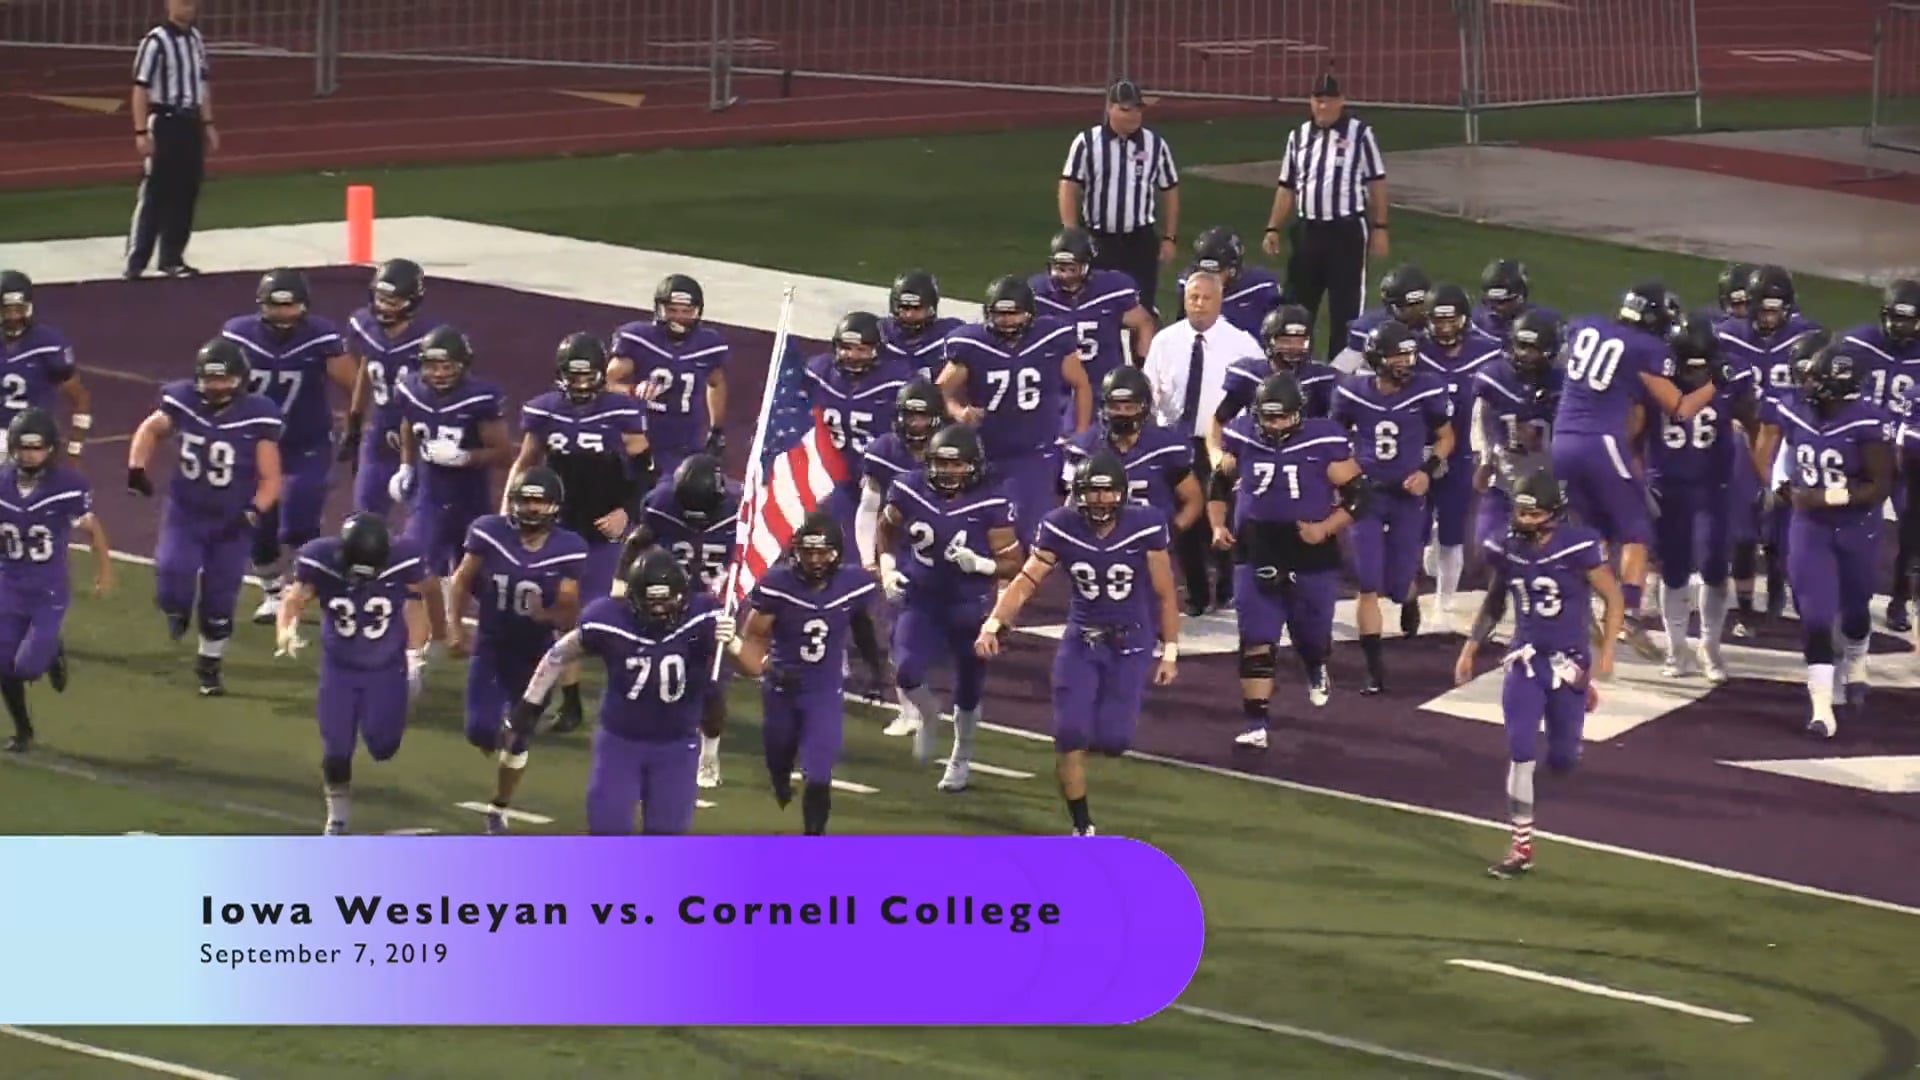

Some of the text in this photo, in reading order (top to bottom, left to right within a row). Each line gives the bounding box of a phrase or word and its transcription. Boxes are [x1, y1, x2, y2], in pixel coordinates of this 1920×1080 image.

[1568, 328, 1625, 391] 90
[3, 373, 29, 409] 2
[647, 367, 695, 413] 21
[986, 367, 1041, 411] 76
[180, 432, 236, 487] 59
[1374, 420, 1400, 460] 6
[1252, 462, 1301, 499] 71
[328, 596, 393, 640] 33
[1511, 576, 1562, 617] 13
[799, 619, 830, 663] 3
[625, 653, 687, 703] 70
